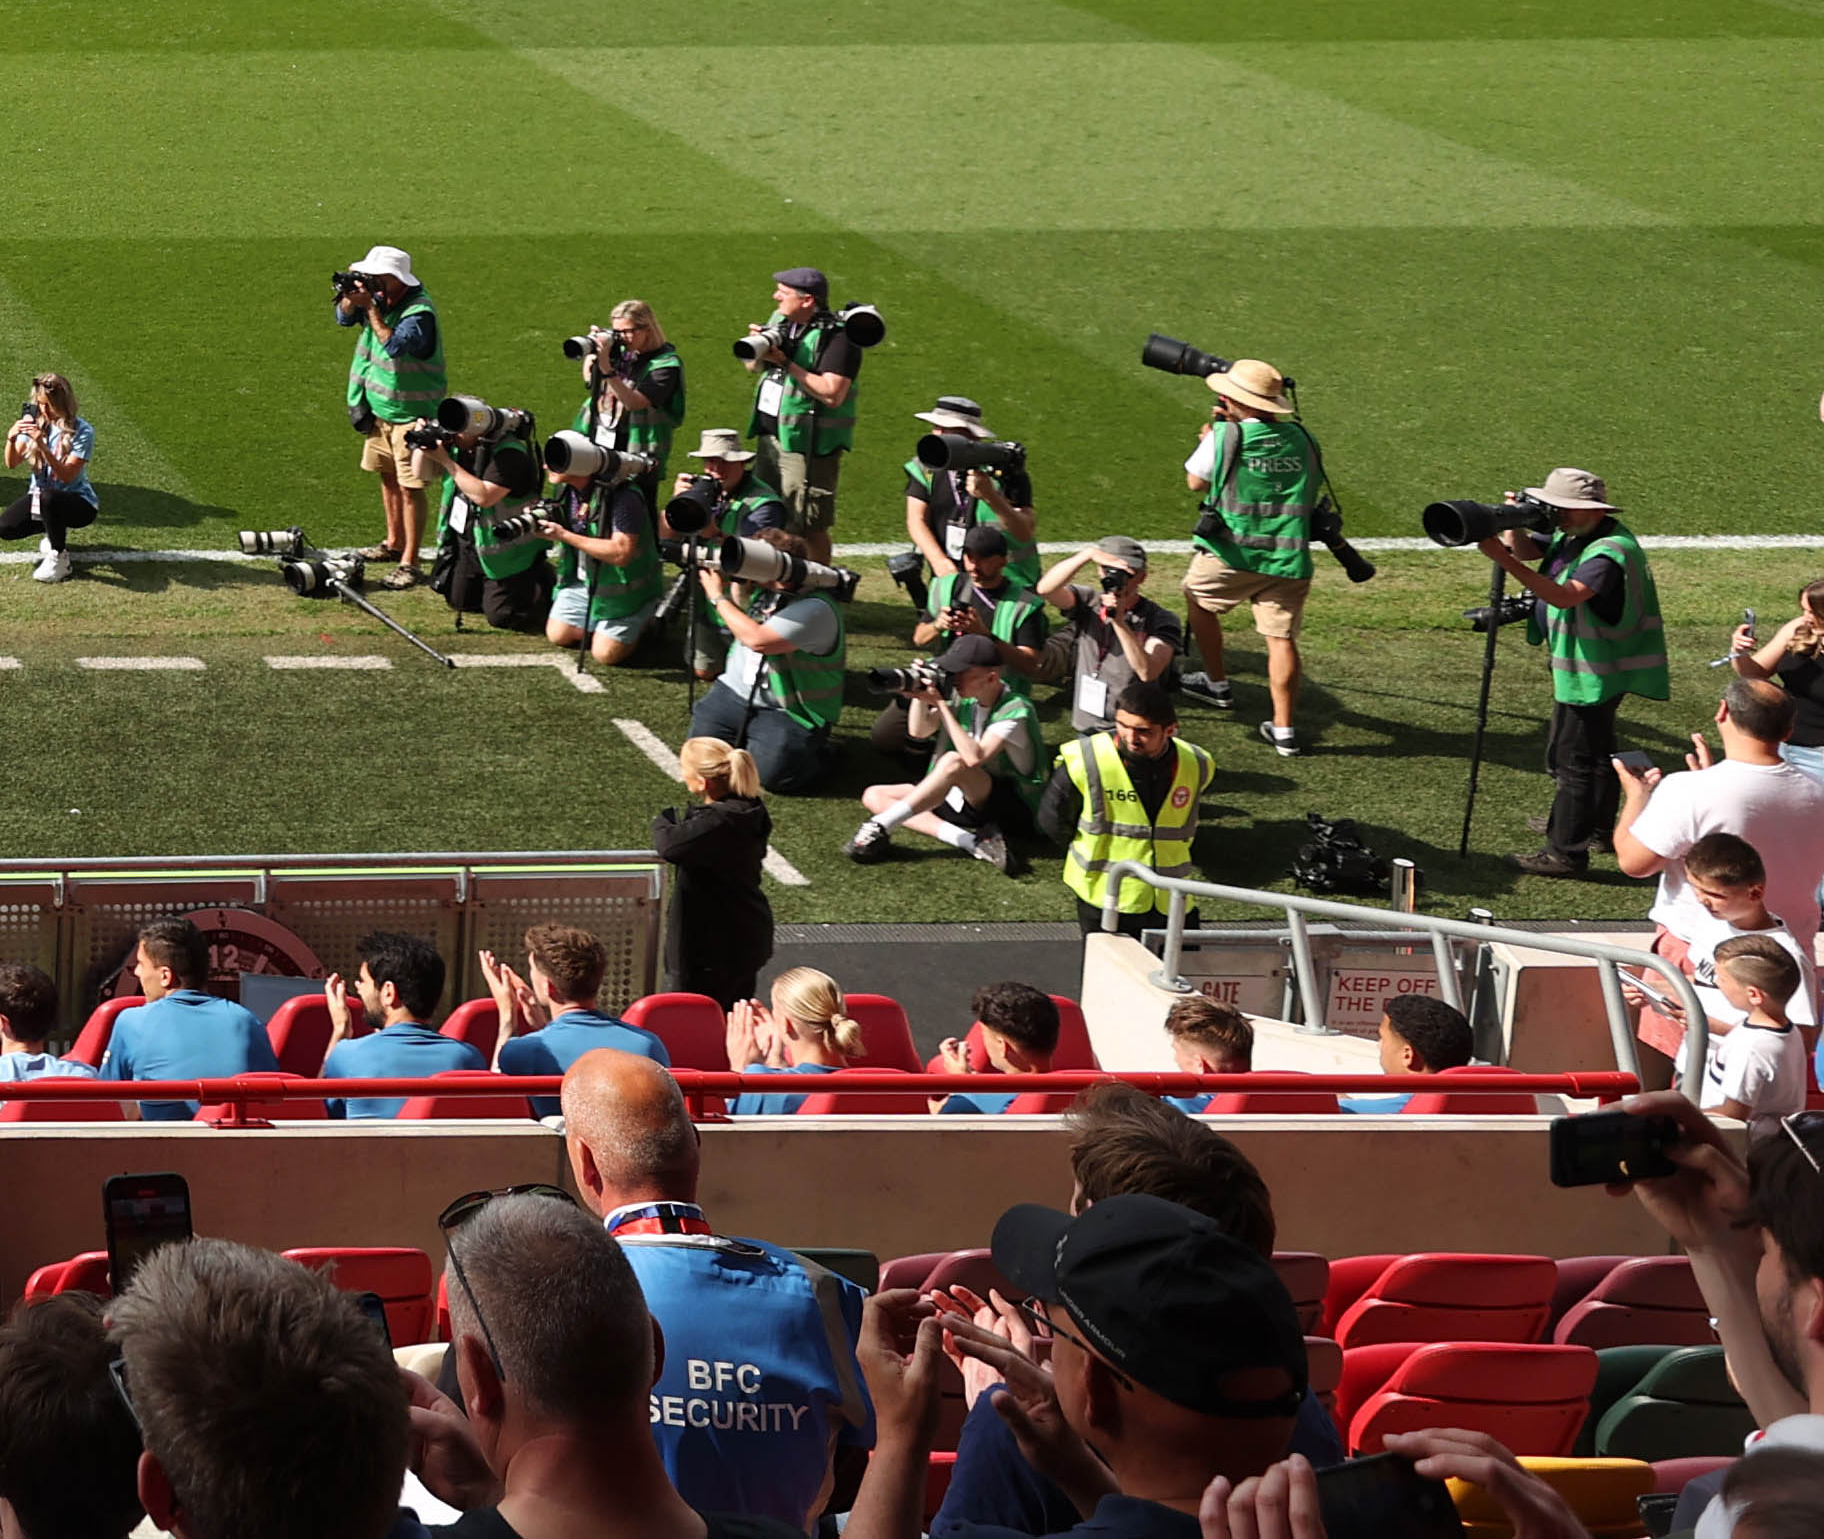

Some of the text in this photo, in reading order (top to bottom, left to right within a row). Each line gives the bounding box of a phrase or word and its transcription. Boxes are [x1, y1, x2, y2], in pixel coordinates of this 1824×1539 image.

[1247, 456, 1301, 474] PRESS
[208, 944, 240, 971] 12
[1202, 981, 1240, 1004] GATE
[1338, 977, 1436, 995] KEEP OFF
[1334, 996, 1373, 1012] THE
[687, 1359, 761, 1394] BFC
[649, 1394, 809, 1432] SECURITY
